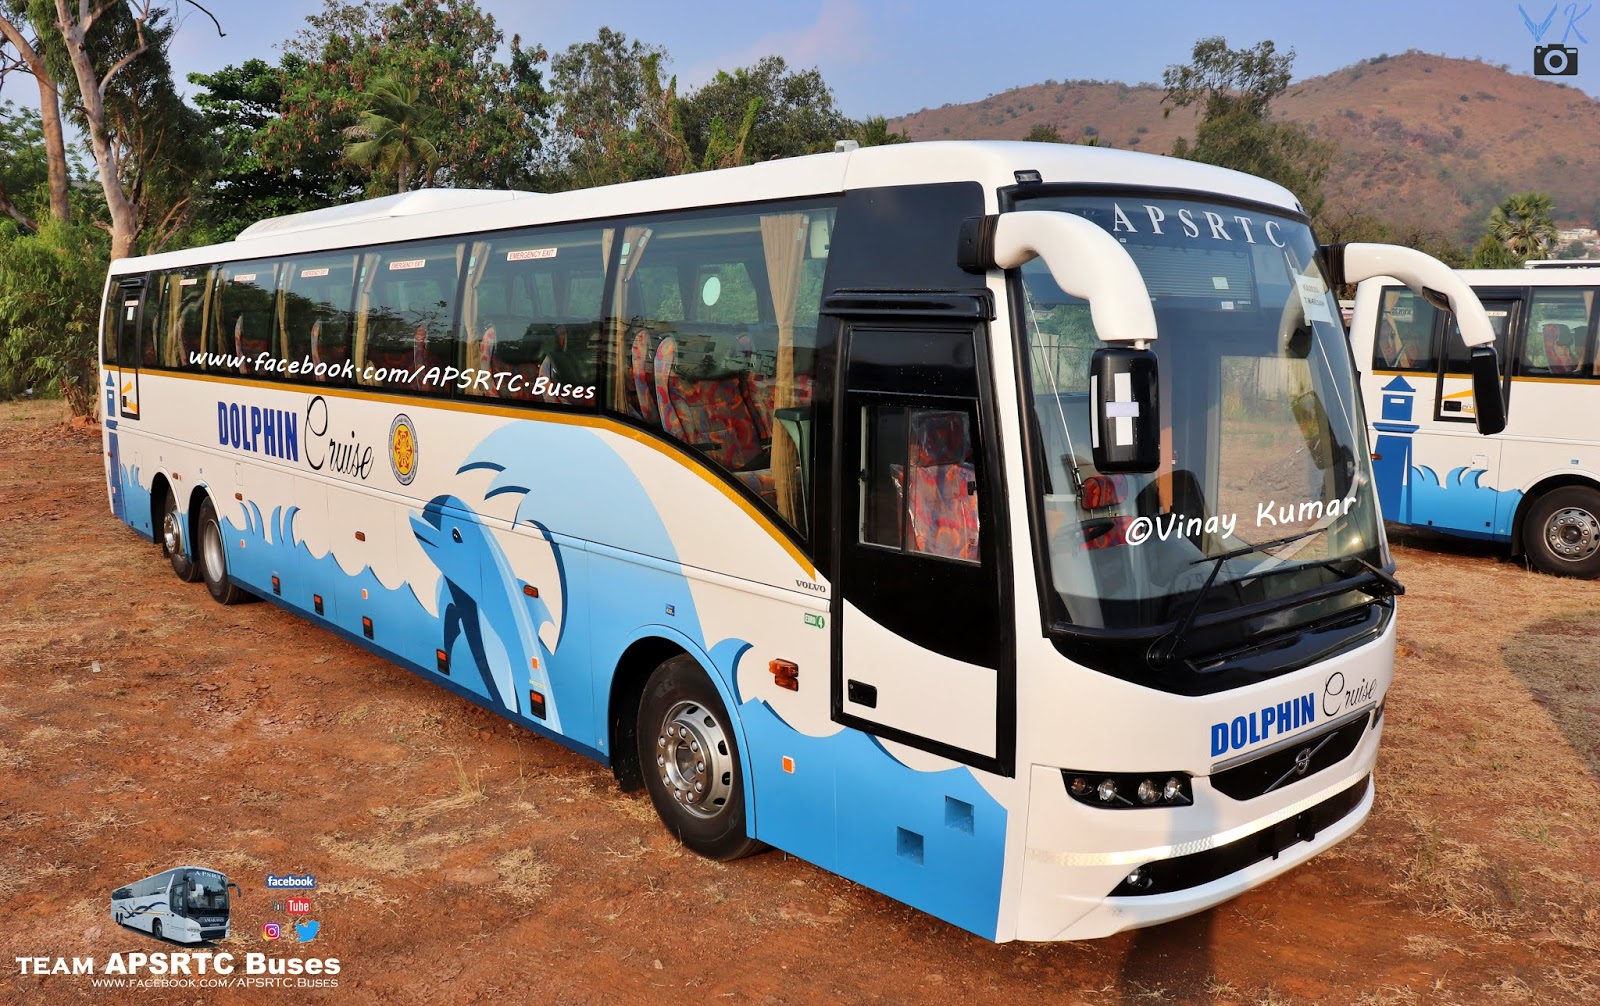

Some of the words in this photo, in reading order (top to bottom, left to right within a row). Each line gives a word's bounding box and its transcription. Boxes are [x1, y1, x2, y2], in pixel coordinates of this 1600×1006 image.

[1112, 202, 1286, 248] APSRTC
[509, 250, 541, 260] EMERGENCY
[541, 249, 555, 257] EXIT
[217, 401, 299, 462] DOLPHIN
[304, 395, 375, 480] Cruise
[795, 579, 826, 593] VOLVO
[1210, 692, 1315, 757] DOLPHIN
[1322, 671, 1378, 717] Cruise
